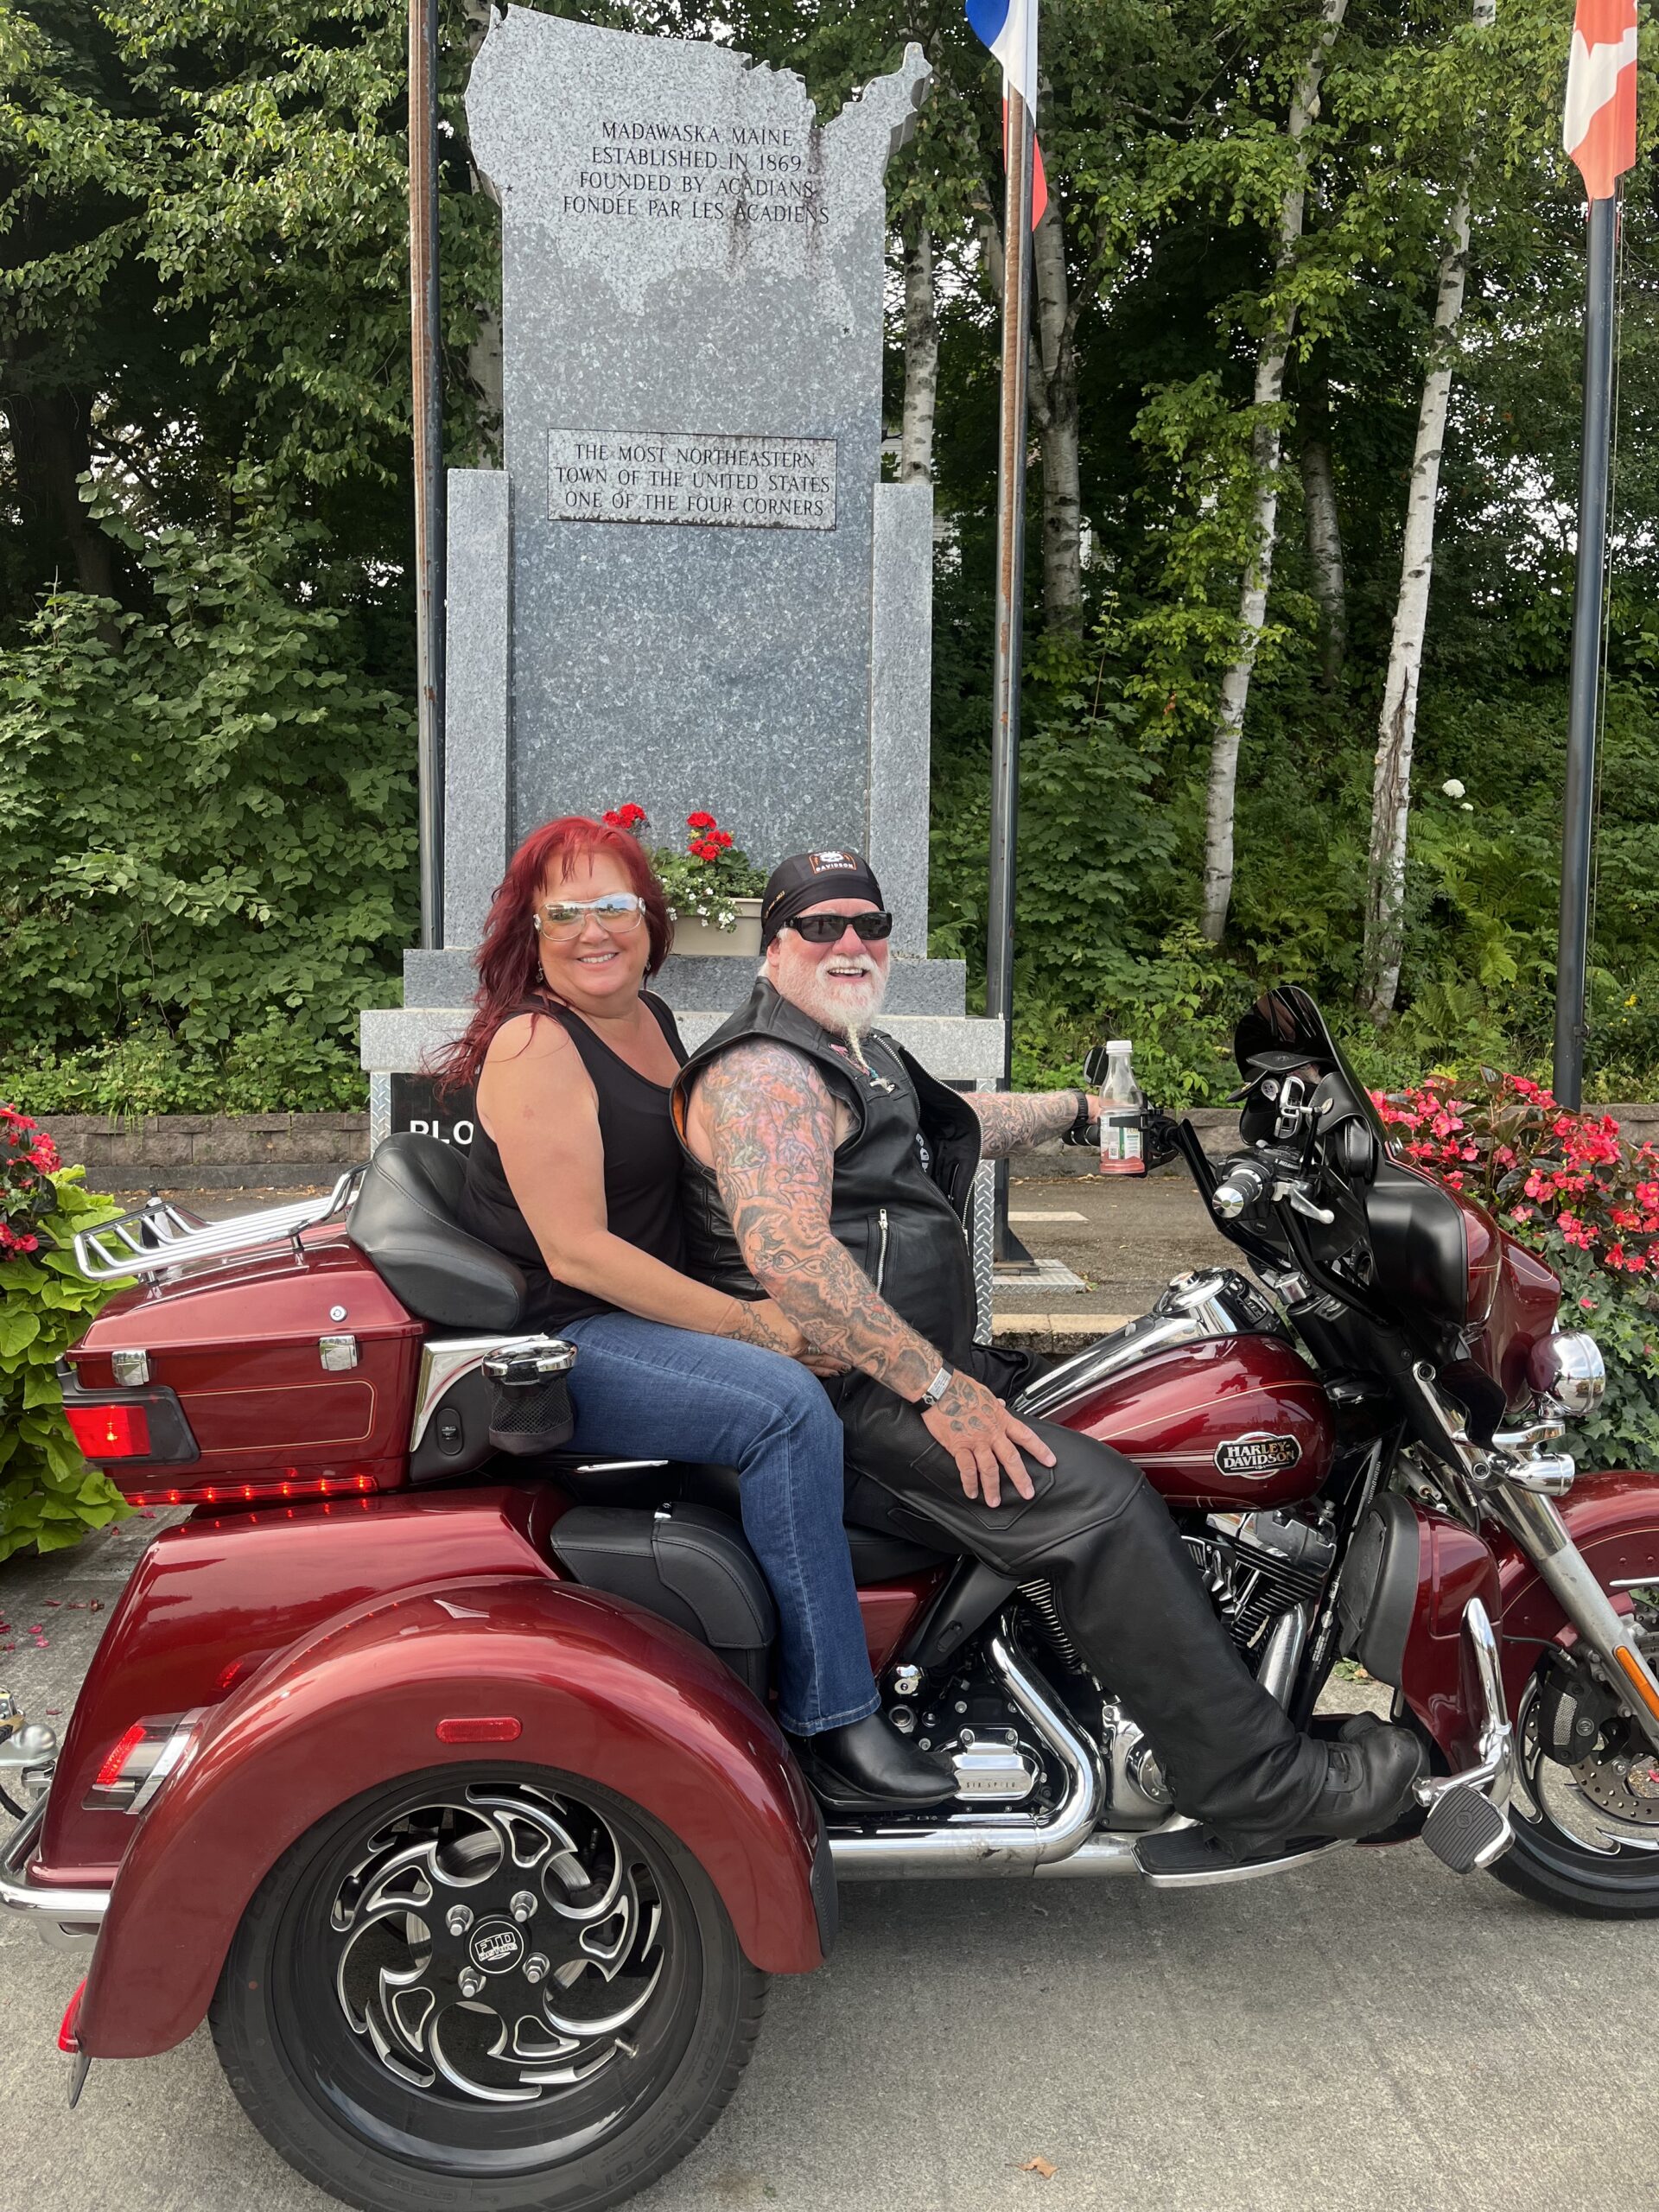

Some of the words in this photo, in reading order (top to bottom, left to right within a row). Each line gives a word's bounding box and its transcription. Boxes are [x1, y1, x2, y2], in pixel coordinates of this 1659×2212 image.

[731, 127, 793, 147] MAINE
[592, 147, 718, 168] ESTABLISHED
[728, 152, 748, 170] IN
[760, 154, 802, 173] 1869
[580, 171, 671, 192] FOUNDED
[683, 176, 706, 193] BY
[718, 178, 814, 199] ACADIANS
[563, 192, 638, 216] FONDÉE
[649, 200, 681, 217] PAR
[692, 201, 724, 219] LES
[735, 203, 830, 225] ACADIENS
[575, 443, 609, 461] THE
[619, 445, 667, 463] MOST
[677, 448, 816, 468] NORTHEASTERN
[556, 467, 607, 484] TOWN
[618, 469, 641, 486] OF
[650, 470, 683, 488] THE
[692, 472, 759, 491] UNITED
[769, 474, 830, 493] STATES
[565, 491, 602, 509] ONE
[612, 493, 635, 510] OF
[644, 493, 677, 511] THE
[688, 496, 733, 513] FOUR
[743, 497, 824, 517] CORNERS
[1223, 1450, 1295, 1469] DAVIDSON
